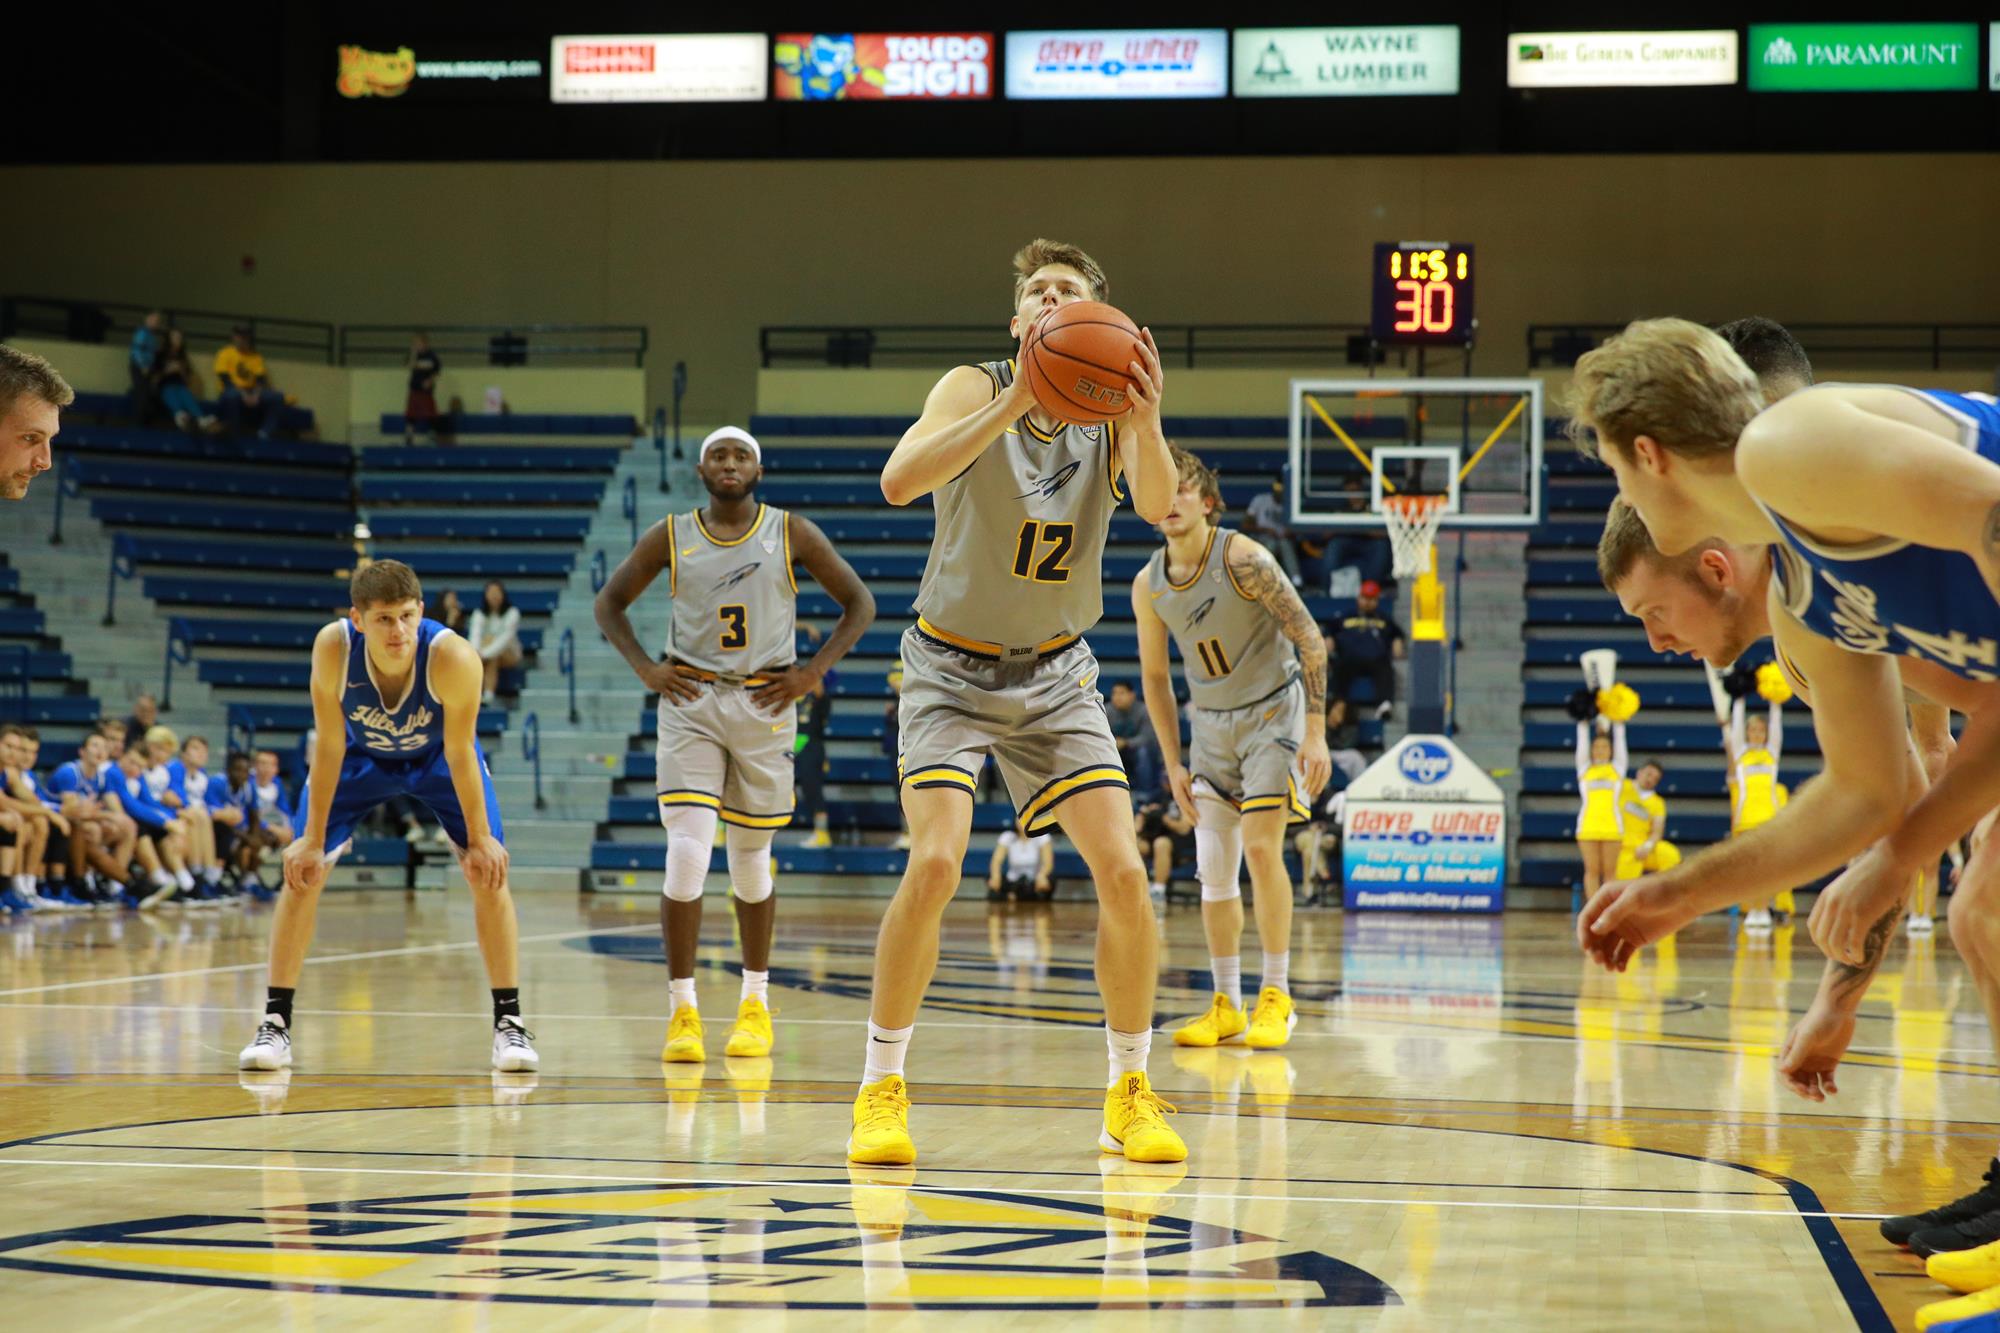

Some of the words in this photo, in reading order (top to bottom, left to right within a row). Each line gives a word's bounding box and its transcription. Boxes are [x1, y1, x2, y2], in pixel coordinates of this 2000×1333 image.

[885, 37, 989, 62] TOLEDO
[1325, 34, 1419, 53] WAYNE
[1806, 43, 1963, 65] PARAMOUNT
[1316, 63, 1428, 82] LUMBER
[1395, 280, 1454, 332] 30
[1073, 377, 1127, 407] ELITE
[1011, 519, 1075, 584] 12
[717, 602, 749, 651] 3
[1009, 646, 1033, 657] TOLEDO
[1195, 634, 1233, 678] 11
[433, 1267, 833, 1288] 1946
